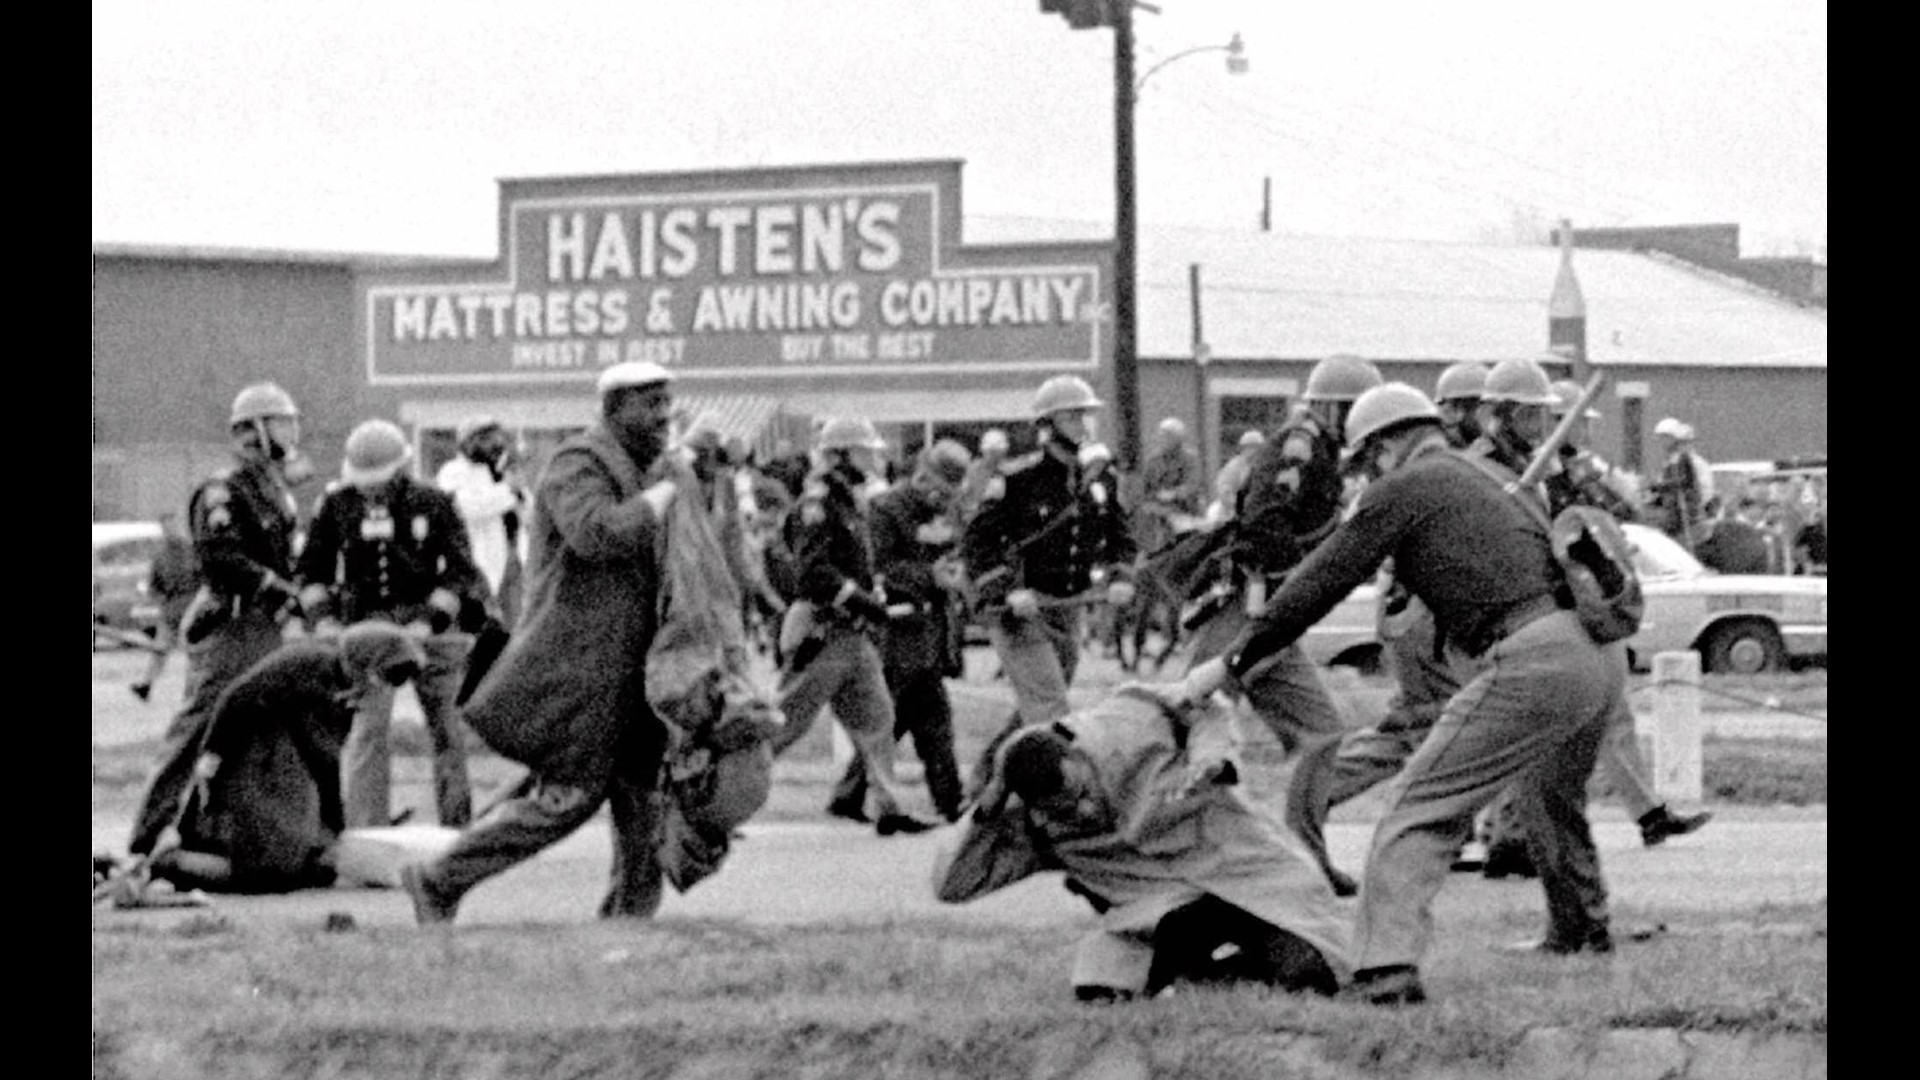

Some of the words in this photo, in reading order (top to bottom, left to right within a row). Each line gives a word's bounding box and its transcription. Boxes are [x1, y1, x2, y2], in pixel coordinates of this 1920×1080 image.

[548, 201, 901, 280] HAISTEN'S
[394, 290, 628, 340] MATTRESS
[647, 288, 673, 333] &
[693, 281, 860, 332] AWNING
[881, 276, 1083, 326] COMPANY
[512, 341, 586, 367] INVEST
[597, 339, 619, 364] IN
[780, 334, 824, 361] BUY
[831, 333, 870, 359] THE
[877, 331, 935, 358] BEST
